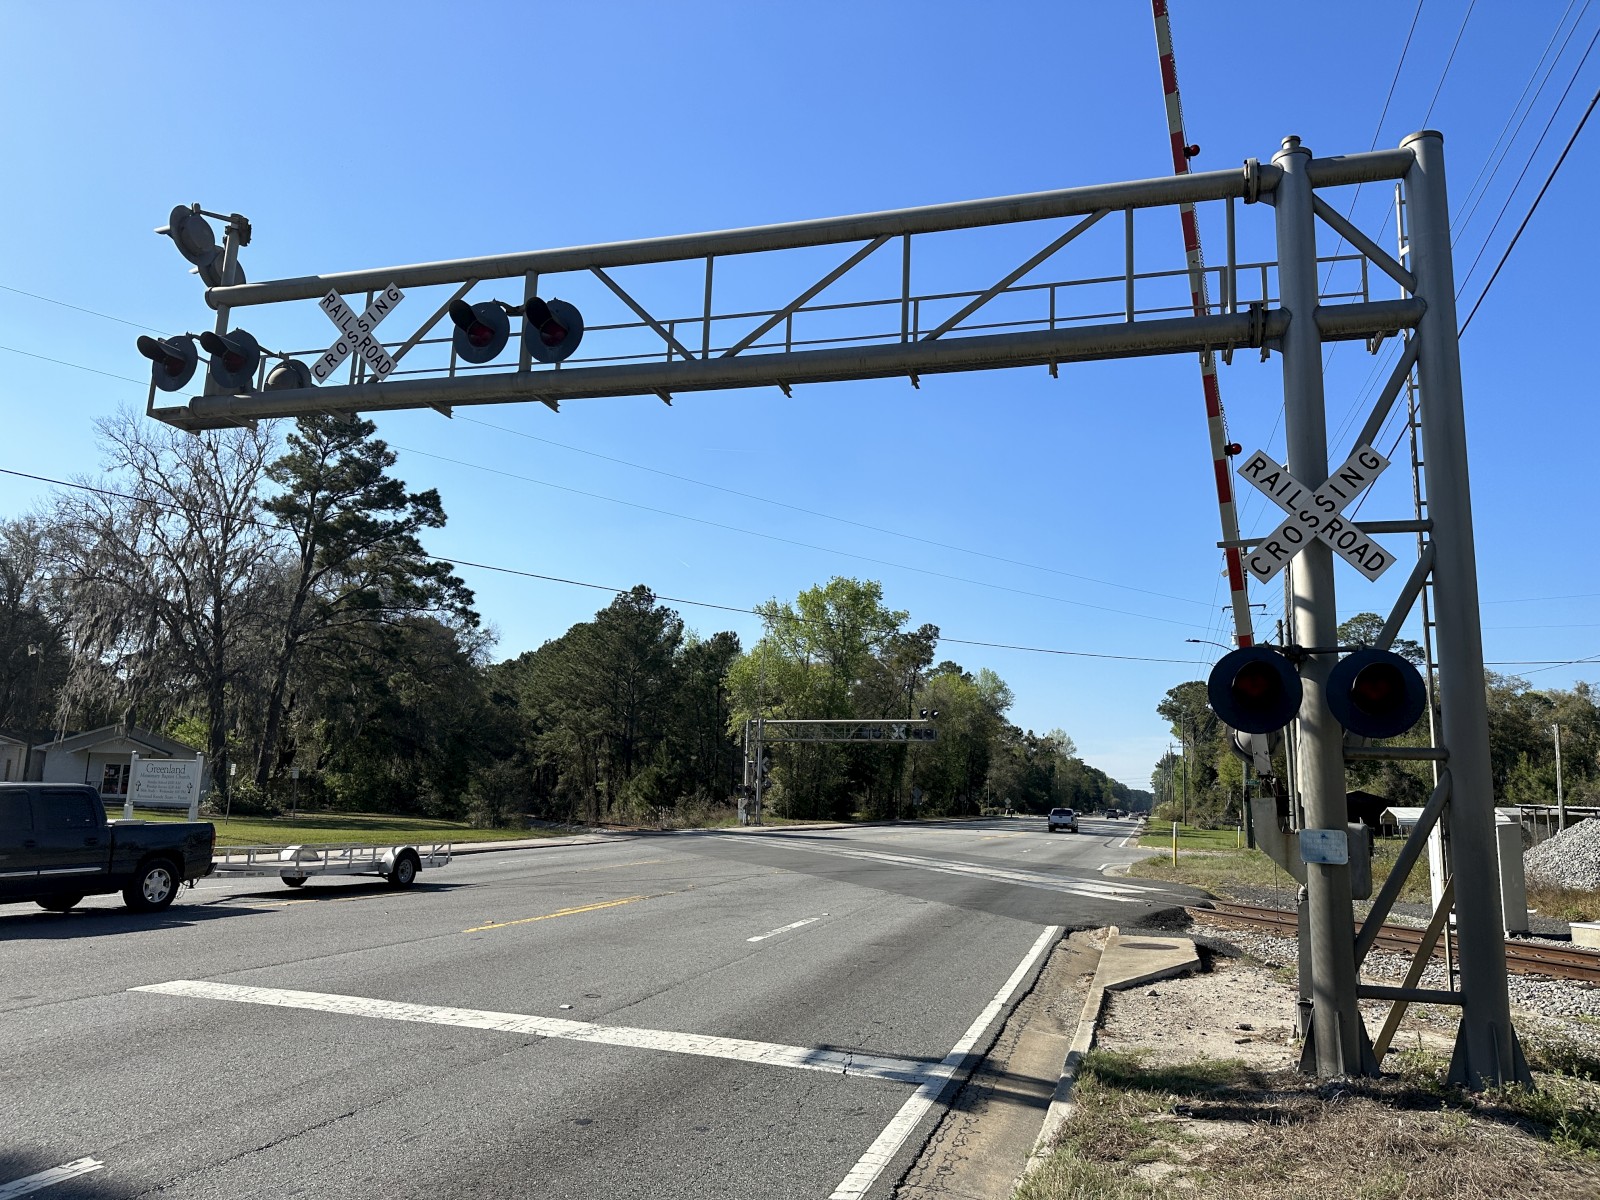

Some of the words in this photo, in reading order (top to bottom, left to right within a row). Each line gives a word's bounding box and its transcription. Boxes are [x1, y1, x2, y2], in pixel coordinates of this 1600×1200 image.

[314, 288, 399, 378] CROSSING
[1250, 452, 1380, 575] CROSSING
[146, 763, 186, 774] Greenland
